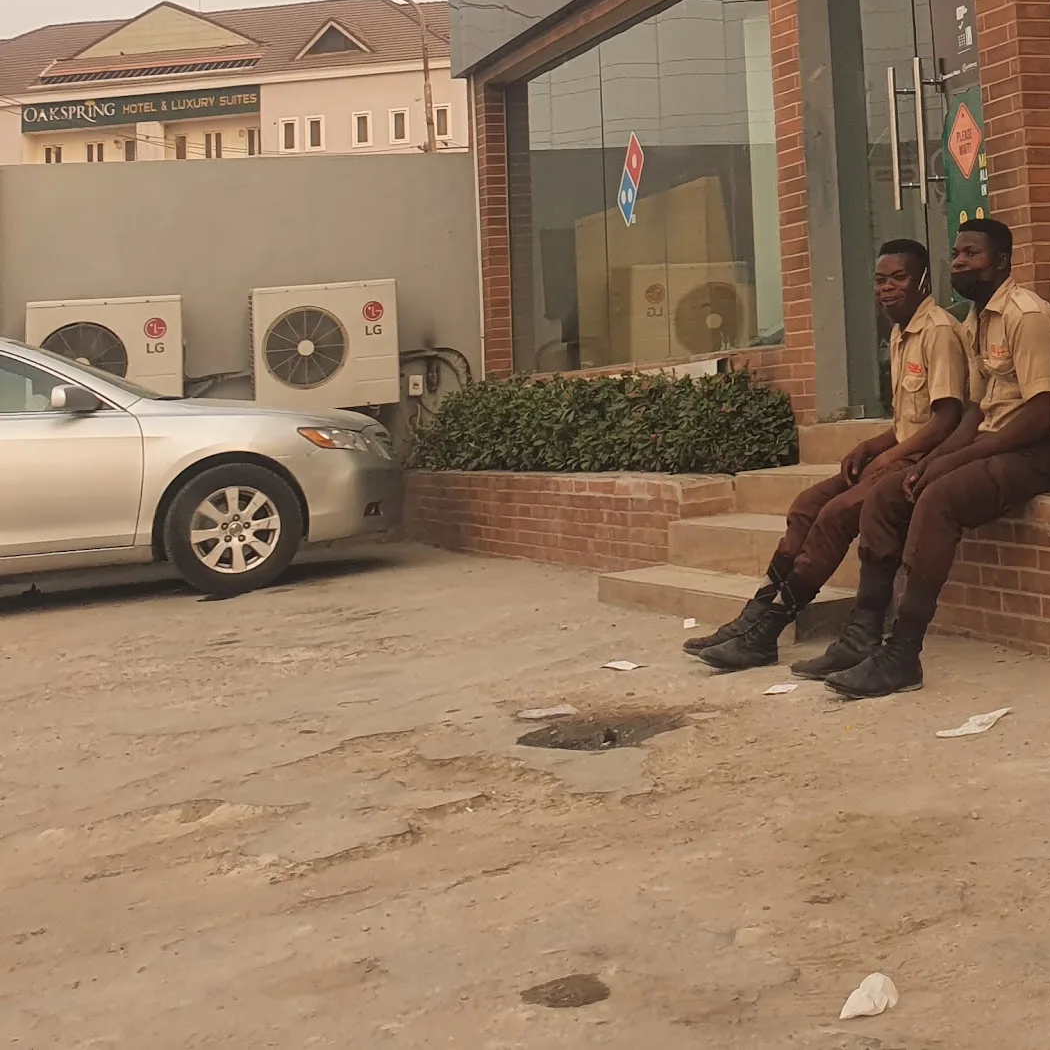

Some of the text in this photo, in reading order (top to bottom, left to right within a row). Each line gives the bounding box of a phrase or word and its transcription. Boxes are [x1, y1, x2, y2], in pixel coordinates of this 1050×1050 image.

[23, 93, 257, 123] OAKSPRING HOTEL & LUXURY SUITES
[956, 129, 972, 143] PLEASE
[365, 325, 382, 336] LG
[146, 342, 165, 354] LG
